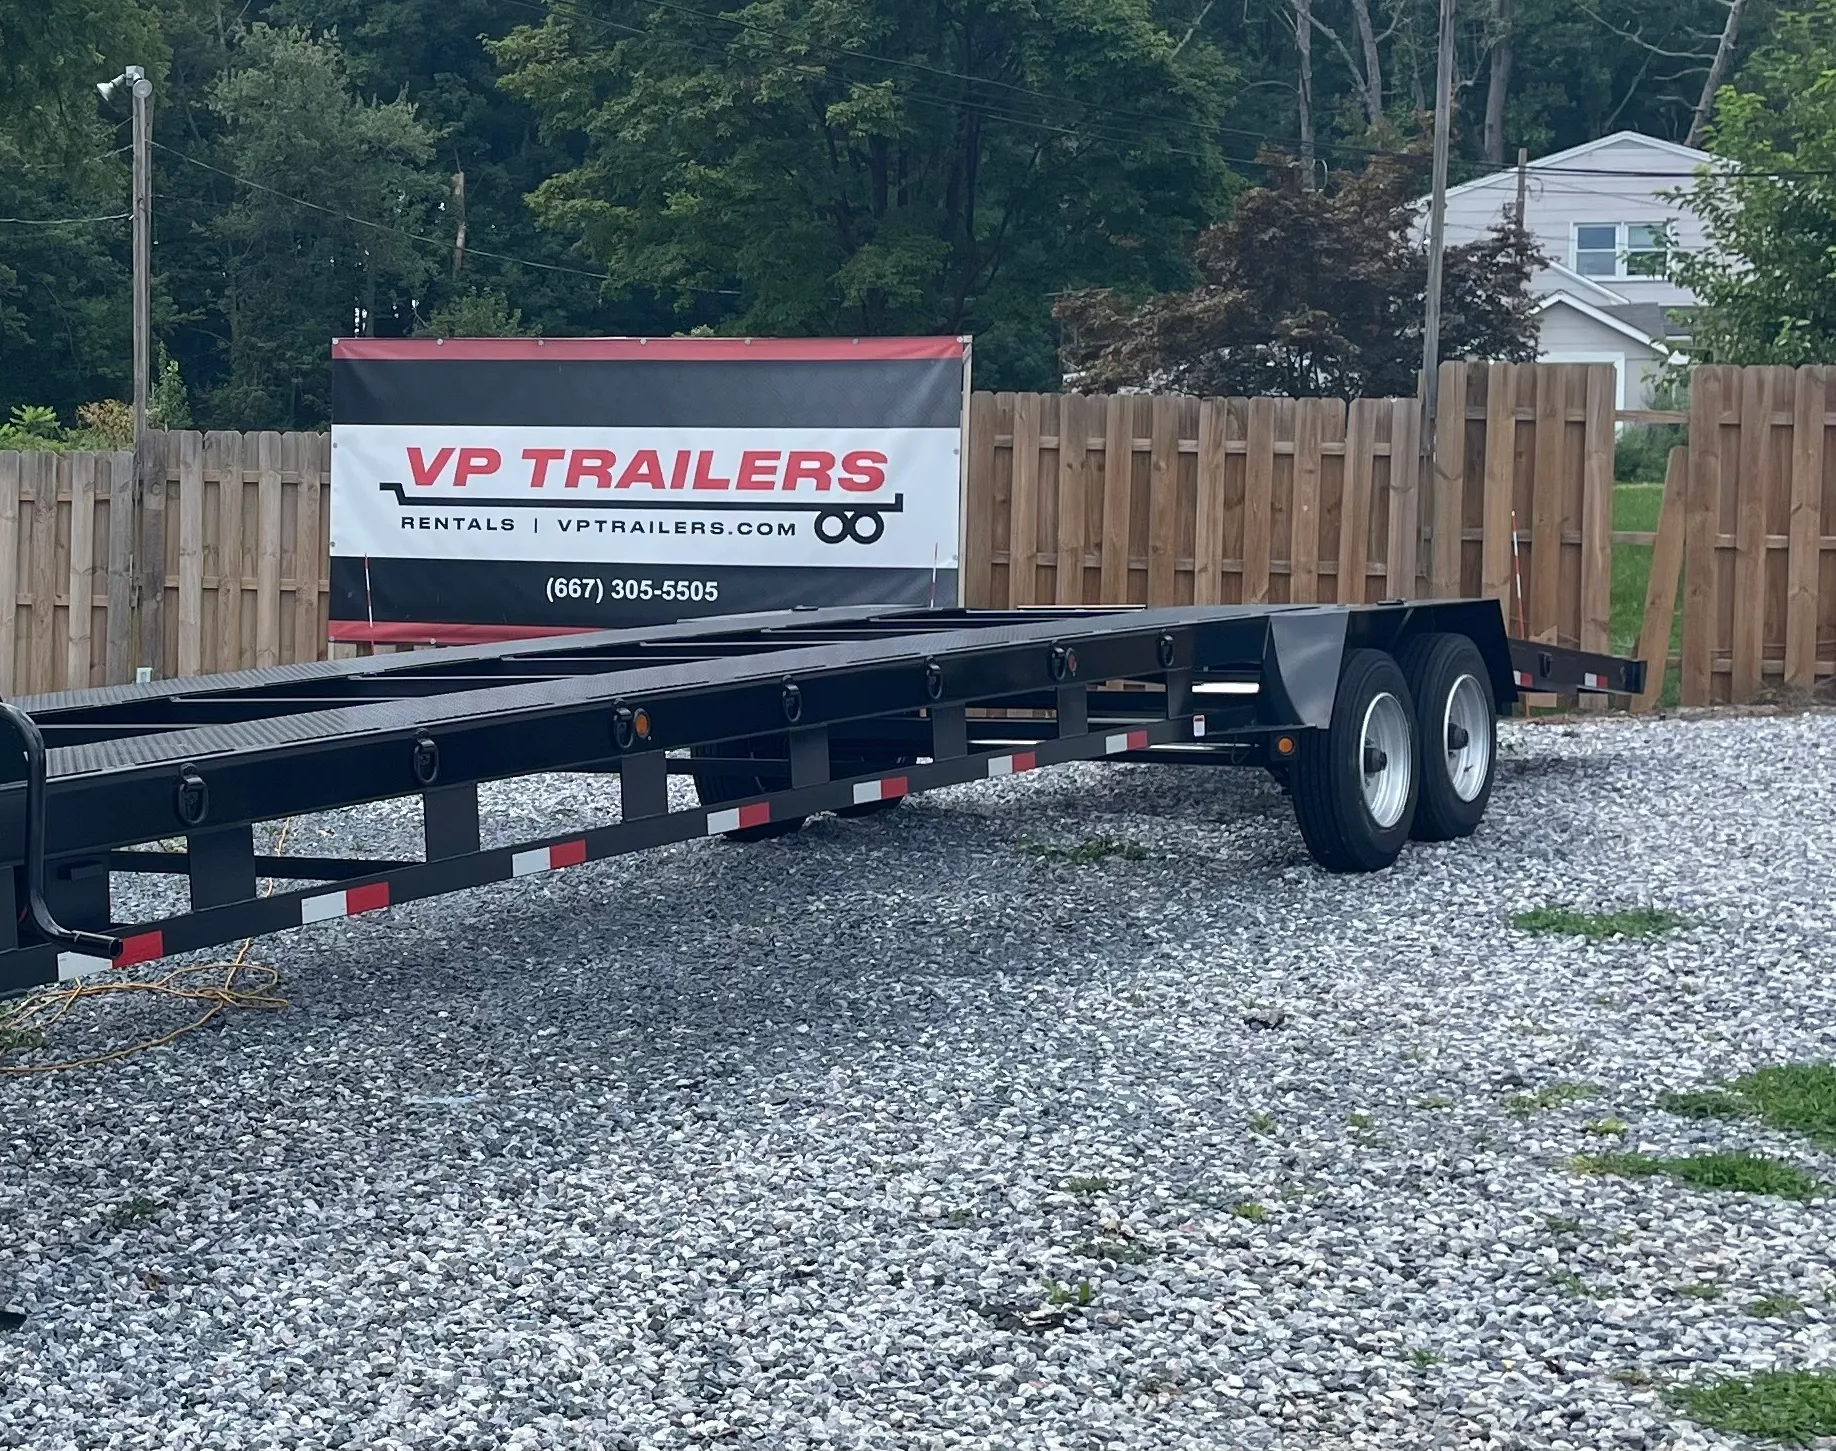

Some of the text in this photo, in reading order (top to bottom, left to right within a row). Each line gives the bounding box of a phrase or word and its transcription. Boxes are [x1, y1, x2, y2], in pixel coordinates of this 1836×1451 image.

[406, 447, 888, 492] VP TRAILERS
[401, 516, 515, 531] RENTALS
[558, 519, 796, 536] VPTRAILERS.COM
[546, 577, 719, 603] (667) 305-5505
